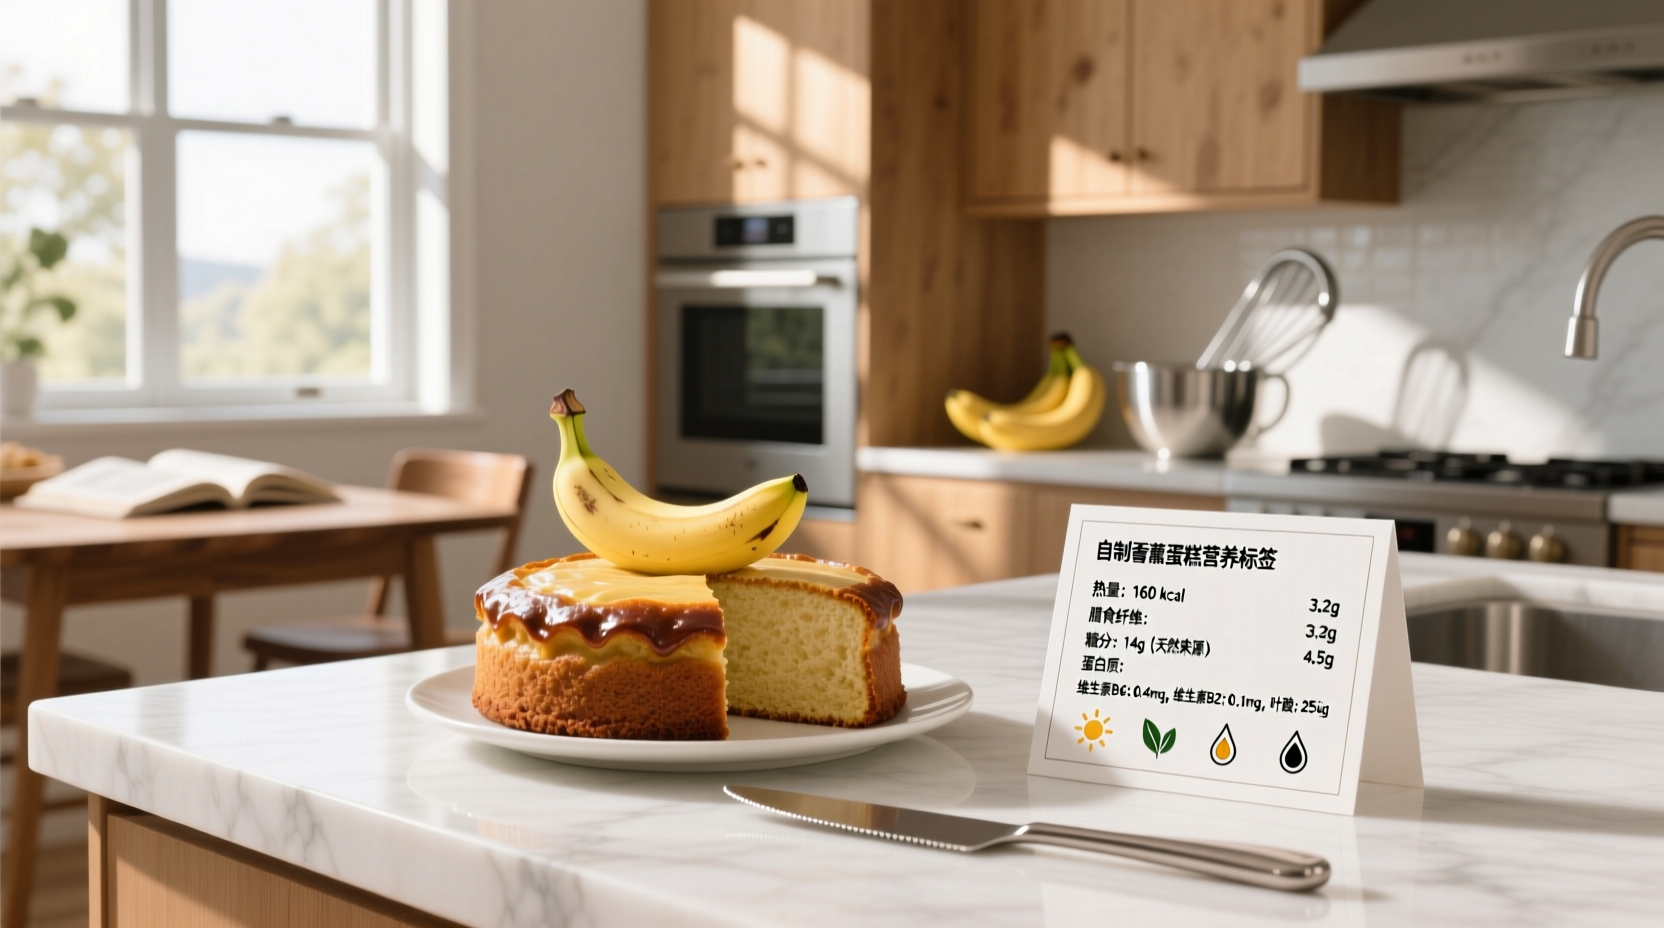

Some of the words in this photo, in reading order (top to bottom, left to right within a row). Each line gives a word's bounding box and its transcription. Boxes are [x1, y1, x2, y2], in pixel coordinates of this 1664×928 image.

[1133, 585, 1157, 600] 160
[1159, 586, 1186, 603] kcal
[1308, 598, 1341, 618] 3.2g
[1124, 636, 1146, 655] 14g
[1303, 649, 1335, 670] 4.5g
